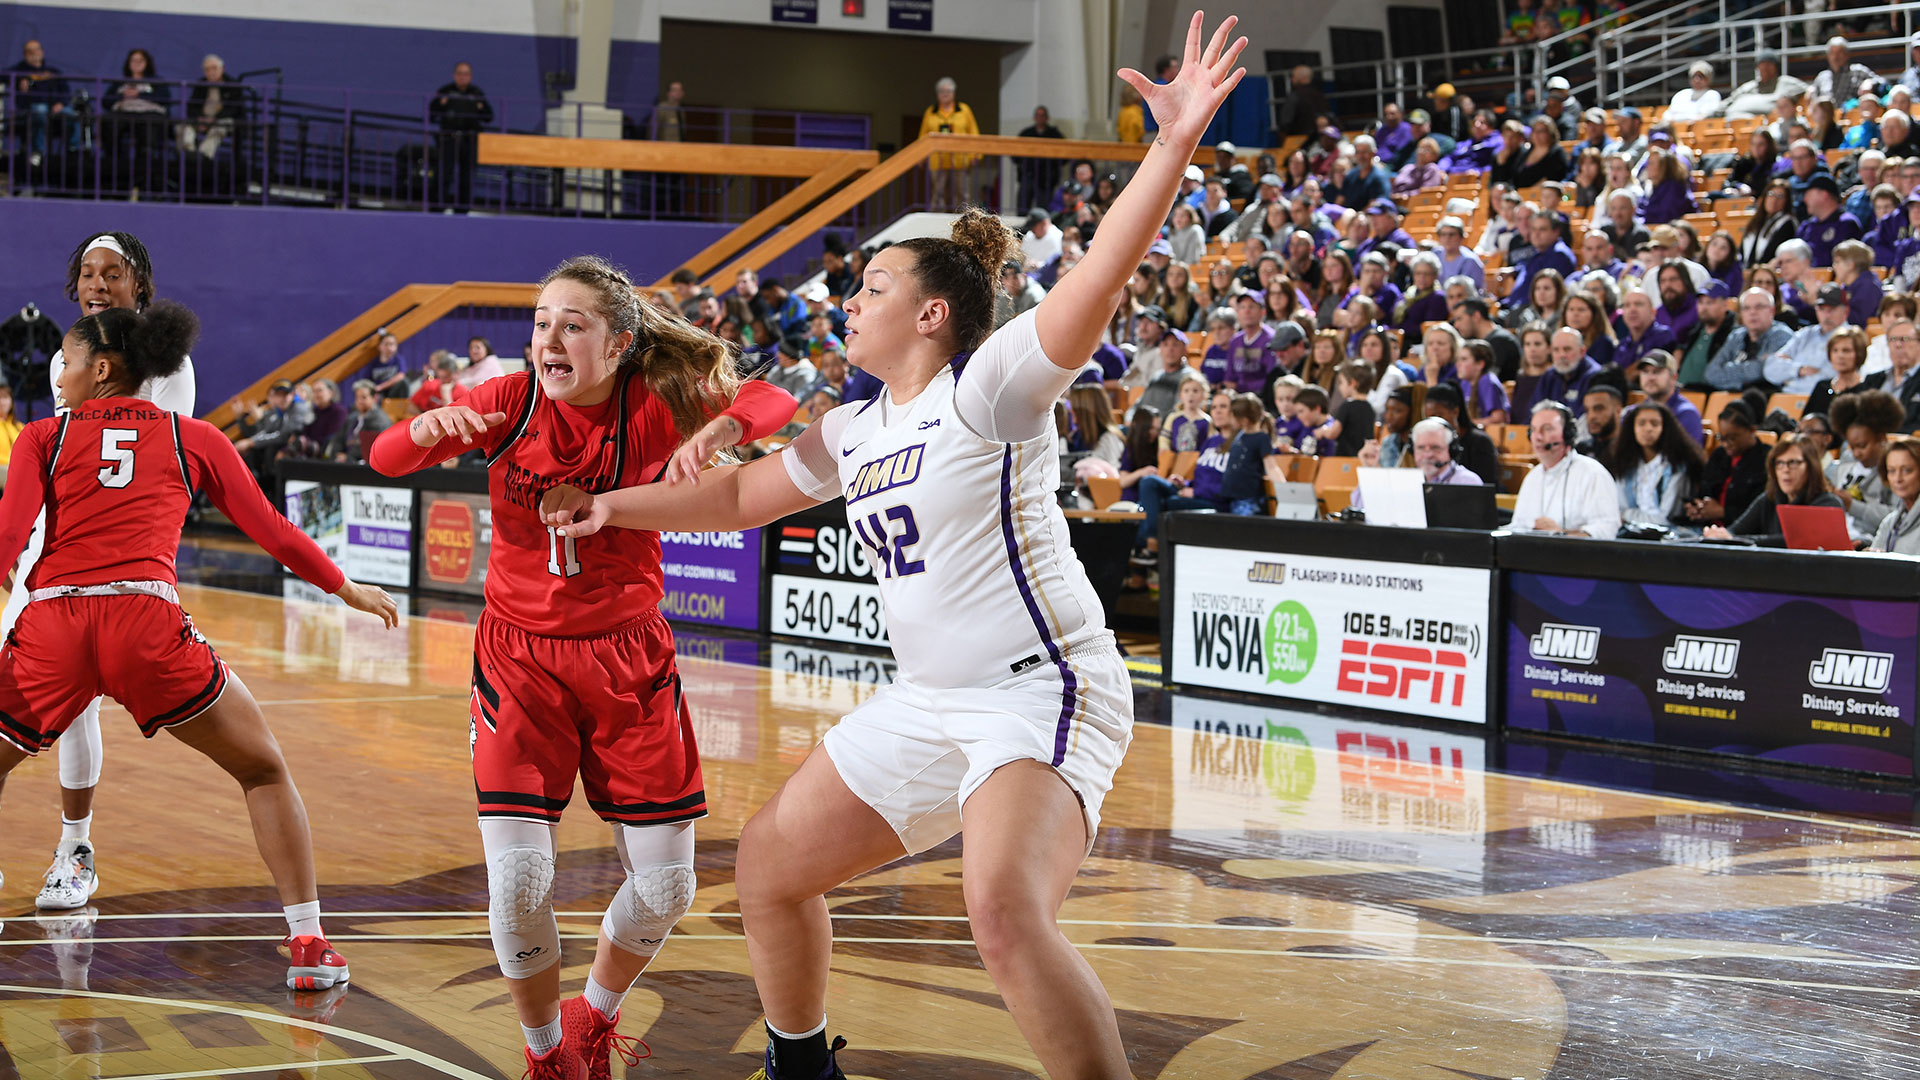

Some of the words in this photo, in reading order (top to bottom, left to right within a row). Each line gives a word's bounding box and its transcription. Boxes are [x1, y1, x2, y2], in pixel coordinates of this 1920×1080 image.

[71, 407, 168, 421] McCARTNEY
[97, 428, 138, 489] 5
[846, 441, 927, 506] JMU
[547, 524, 582, 577] 11
[816, 525, 876, 578] SIG
[855, 504, 926, 579] 42
[1248, 561, 1286, 585] JMU
[1291, 567, 1338, 584] FLAGSHIP
[1341, 572, 1373, 588] RADIO
[1376, 576, 1424, 592] STATIONS
[660, 590, 725, 621] MU.COM
[785, 588, 890, 641] 540-43
[1192, 592, 1264, 615] NEWS/TALK
[1193, 610, 1264, 675] WSVA
[1530, 624, 1600, 664] JMU
[1662, 635, 1740, 678] JMU
[1337, 639, 1467, 707] ESPN
[1523, 664, 1560, 686] Dining
[1560, 667, 1605, 687] Services
[1656, 678, 1695, 700] Dining
[1696, 682, 1746, 702] Services
[1809, 648, 1893, 693] JMU
[1802, 693, 1844, 716] Dining
[1846, 698, 1900, 718] Services
